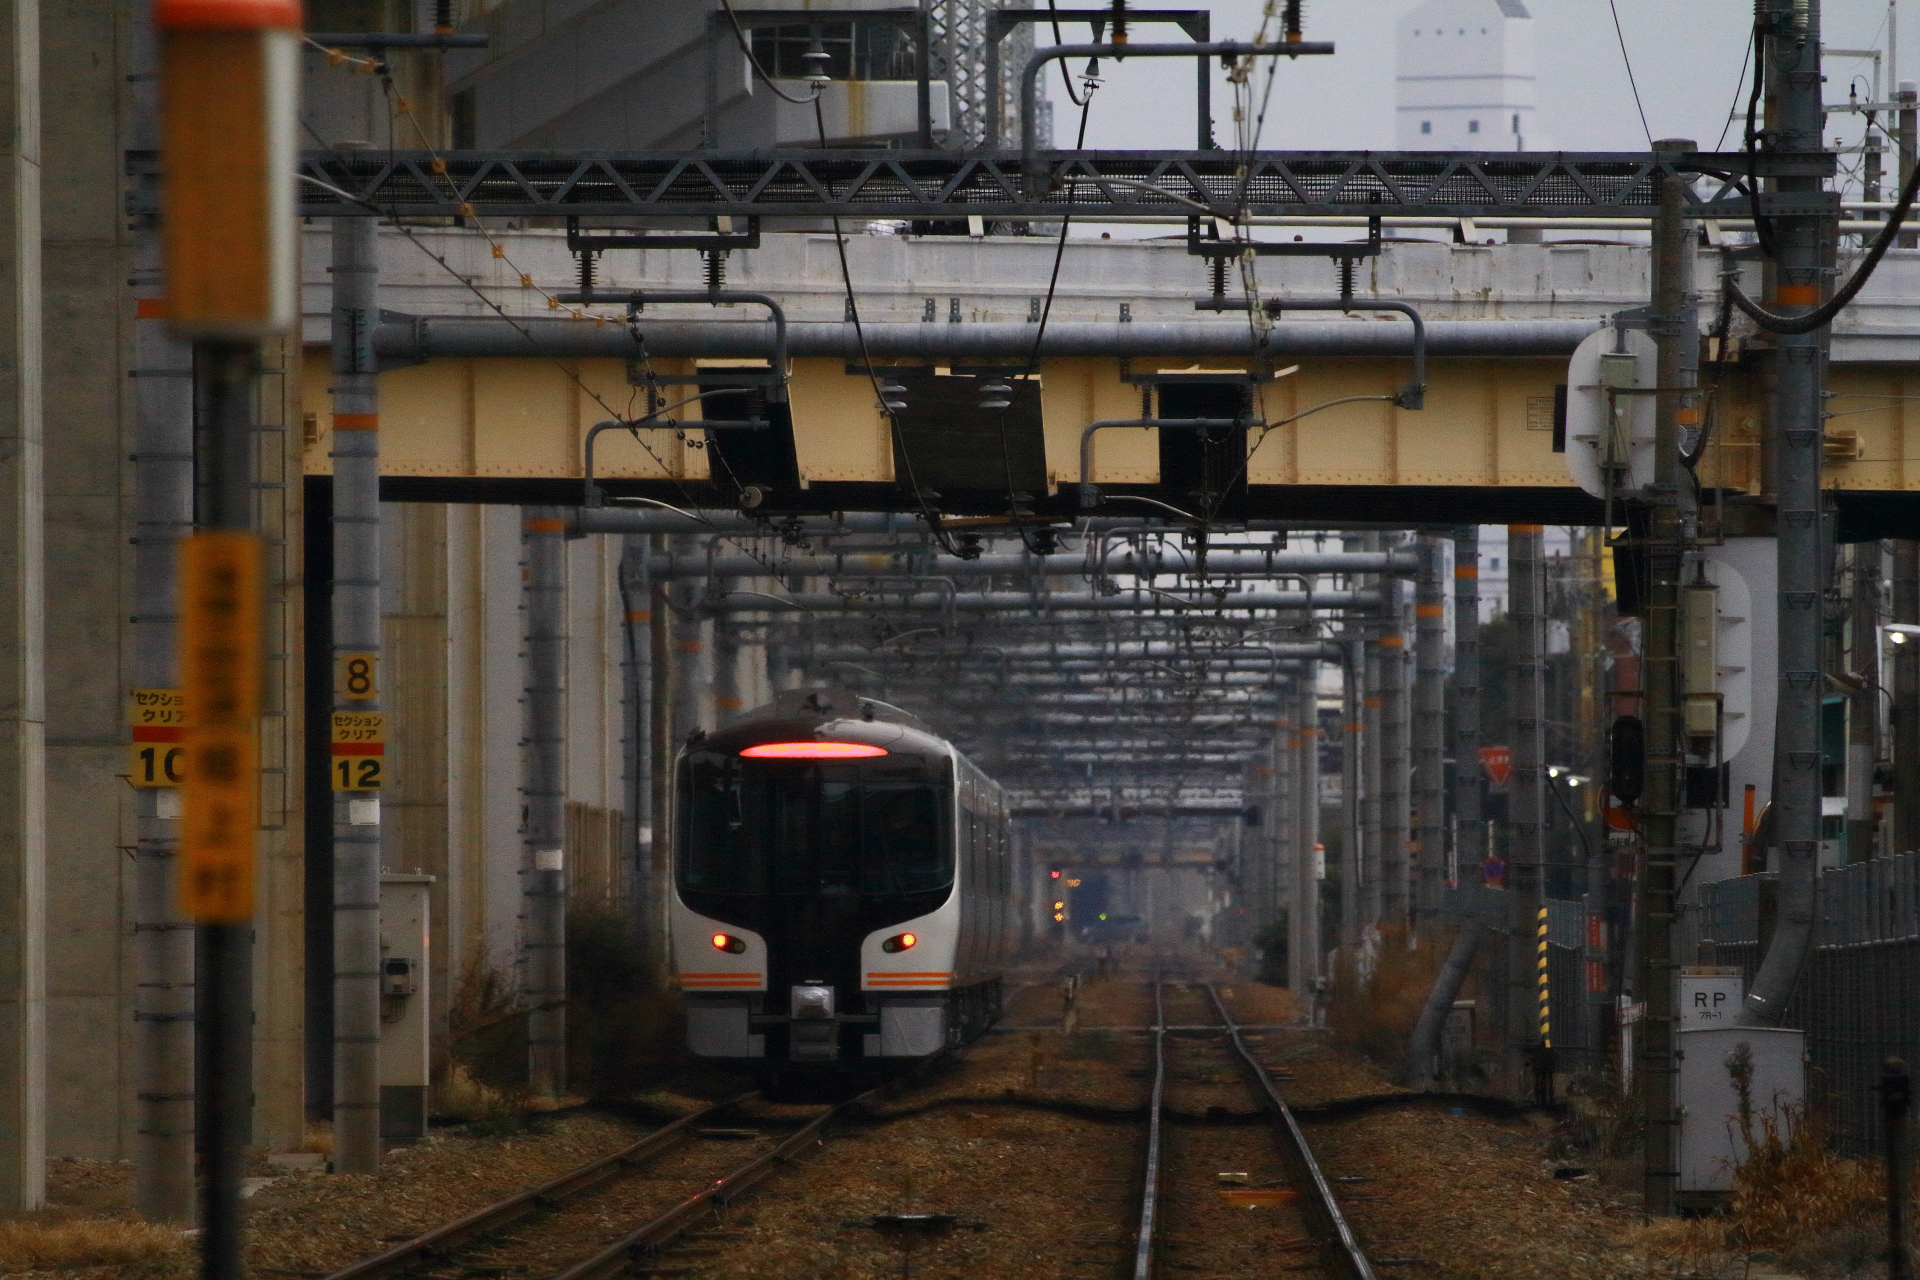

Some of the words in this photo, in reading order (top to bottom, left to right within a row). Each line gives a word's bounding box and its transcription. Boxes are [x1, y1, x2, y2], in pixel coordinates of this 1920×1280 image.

[348, 659, 370, 694] 8
[136, 692, 184, 706] セクショ
[334, 716, 382, 727] セクション
[339, 729, 377, 740] クリア
[338, 759, 381, 787] 12
